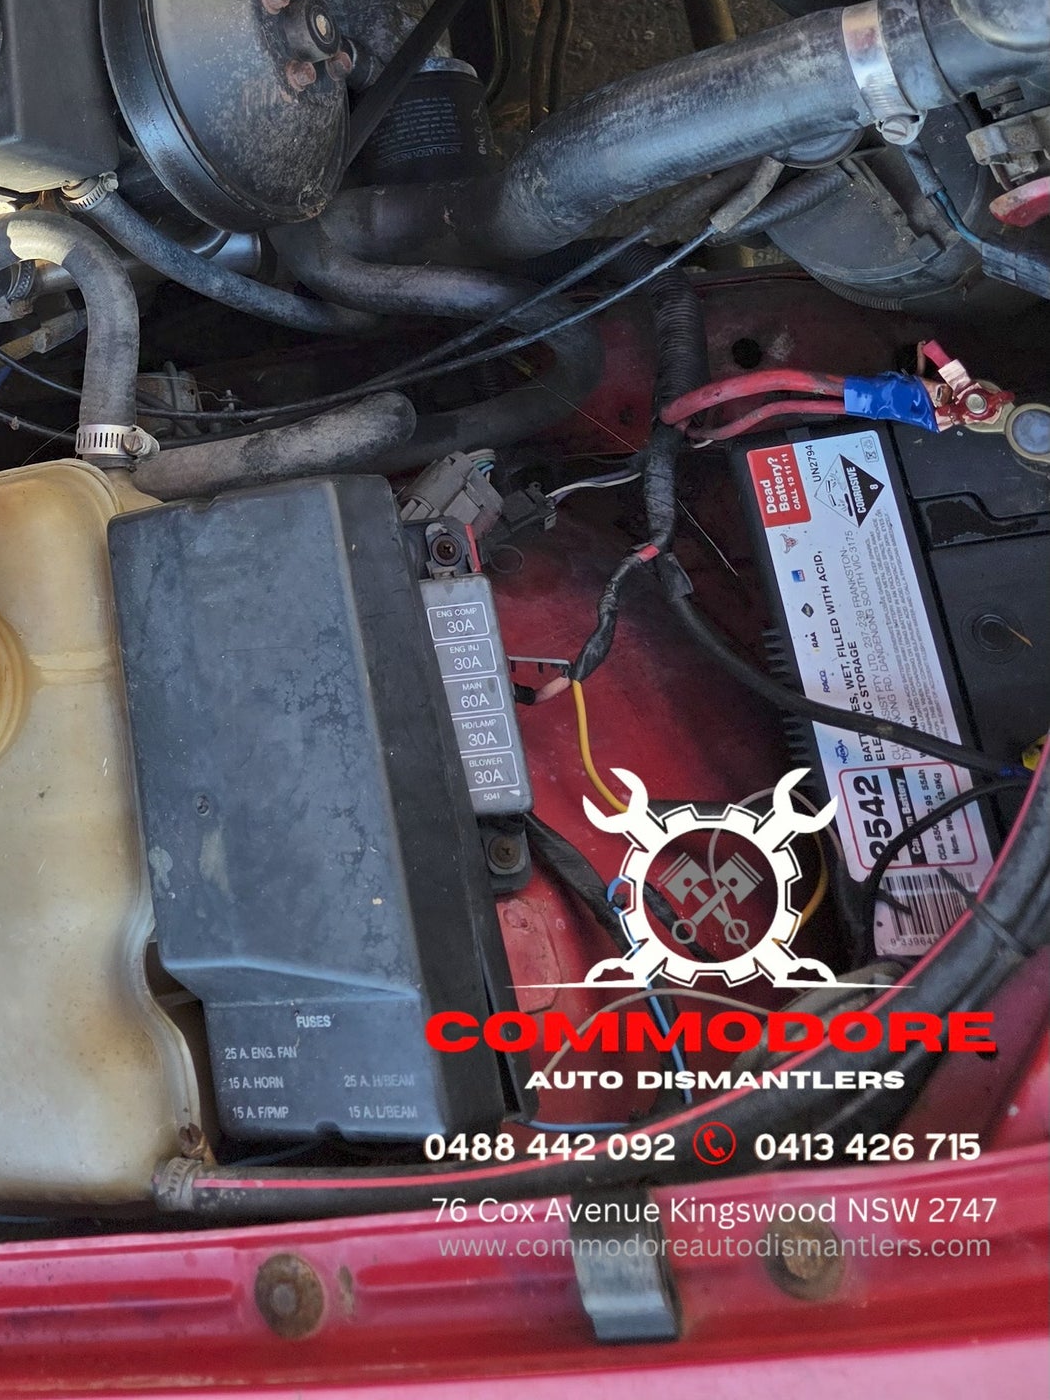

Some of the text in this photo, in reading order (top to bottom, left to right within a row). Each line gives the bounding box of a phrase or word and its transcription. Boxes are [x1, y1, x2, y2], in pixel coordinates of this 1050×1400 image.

[804, 444, 822, 482] UN2794
[766, 454, 792, 512] Battery?
[780, 452, 801, 510] CALL 13 11 11
[869, 482, 878, 490] 8
[759, 478, 777, 513] Dead
[846, 465, 866, 514] CORROSIVE
[843, 529, 857, 553] 3175
[849, 553, 861, 570] VIC
[838, 545, 862, 607] FRANKSTON-
[855, 573, 871, 606] SOUTH
[436, 608, 477, 618] ENG COMP
[447, 620, 475, 633] 30A
[854, 609, 872, 648] 237-239
[863, 607, 889, 672] DANDENONG
[450, 645, 465, 654] ENG
[812, 550, 873, 762] BATTES, WET, FILLED WITH ACID,
[454, 657, 482, 670] 30A
[462, 682, 482, 691] MAIN
[870, 670, 883, 693] PTY
[460, 693, 489, 708] 60A
[847, 640, 885, 761] ELEIC STORAGE
[461, 719, 497, 730] HD/LAMP
[885, 692, 912, 760] DNONG
[468, 733, 497, 746] 30A
[469, 757, 503, 766] BLOWER
[475, 770, 503, 784] 30A
[895, 777, 912, 814] Battery
[923, 794, 933, 806] 95
[851, 771, 898, 865] 2542
[935, 843, 946, 860] CCA
[297, 1016, 331, 1028] FUSES
[225, 1048, 238, 1059] 25
[251, 1047, 276, 1059] ENG.
[278, 1047, 297, 1058] FAN
[228, 1077, 240, 1089] 15
[254, 1077, 284, 1088] HORN
[344, 1075, 356, 1087] 25
[373, 1074, 415, 1087] H/BEAM
[233, 1107, 244, 1119] 15
[258, 1106, 289, 1119] F/PMP
[349, 1106, 361, 1118] 15
[377, 1106, 418, 1118] L/BEAM
